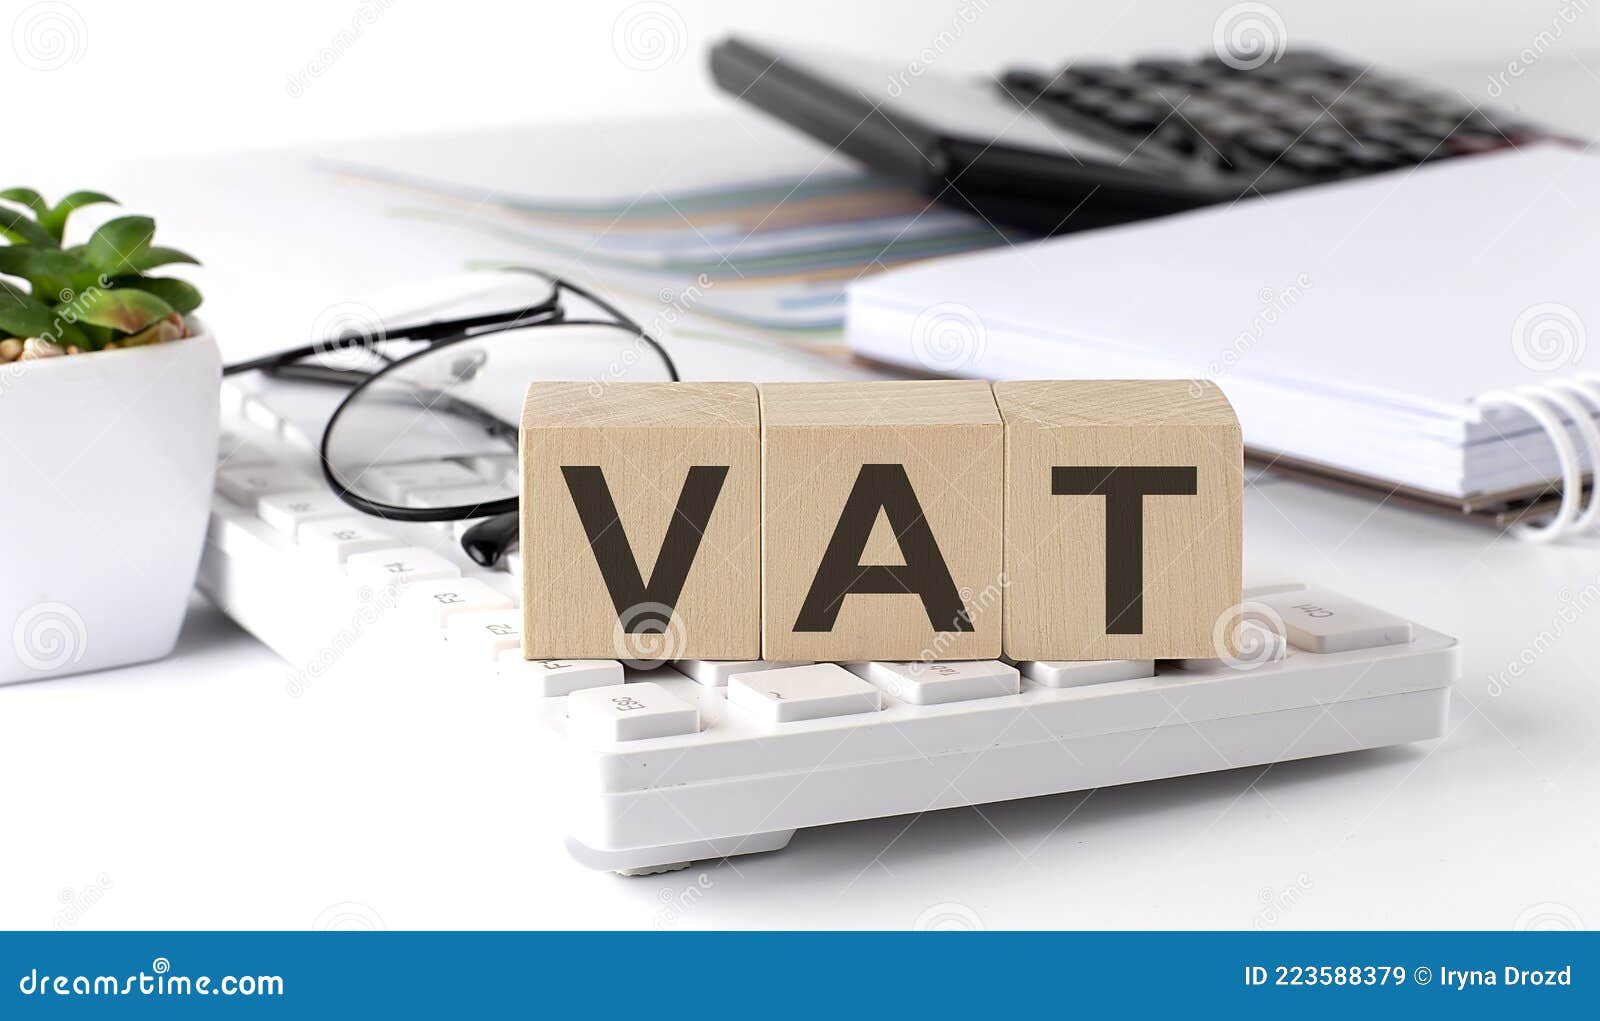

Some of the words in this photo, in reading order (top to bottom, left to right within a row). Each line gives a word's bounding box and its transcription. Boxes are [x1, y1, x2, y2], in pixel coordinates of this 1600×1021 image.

[562, 464, 1198, 635] VAT
[433, 592, 466, 604] F3
[1290, 603, 1334, 618] Ctrl
[485, 623, 519, 635] F2
